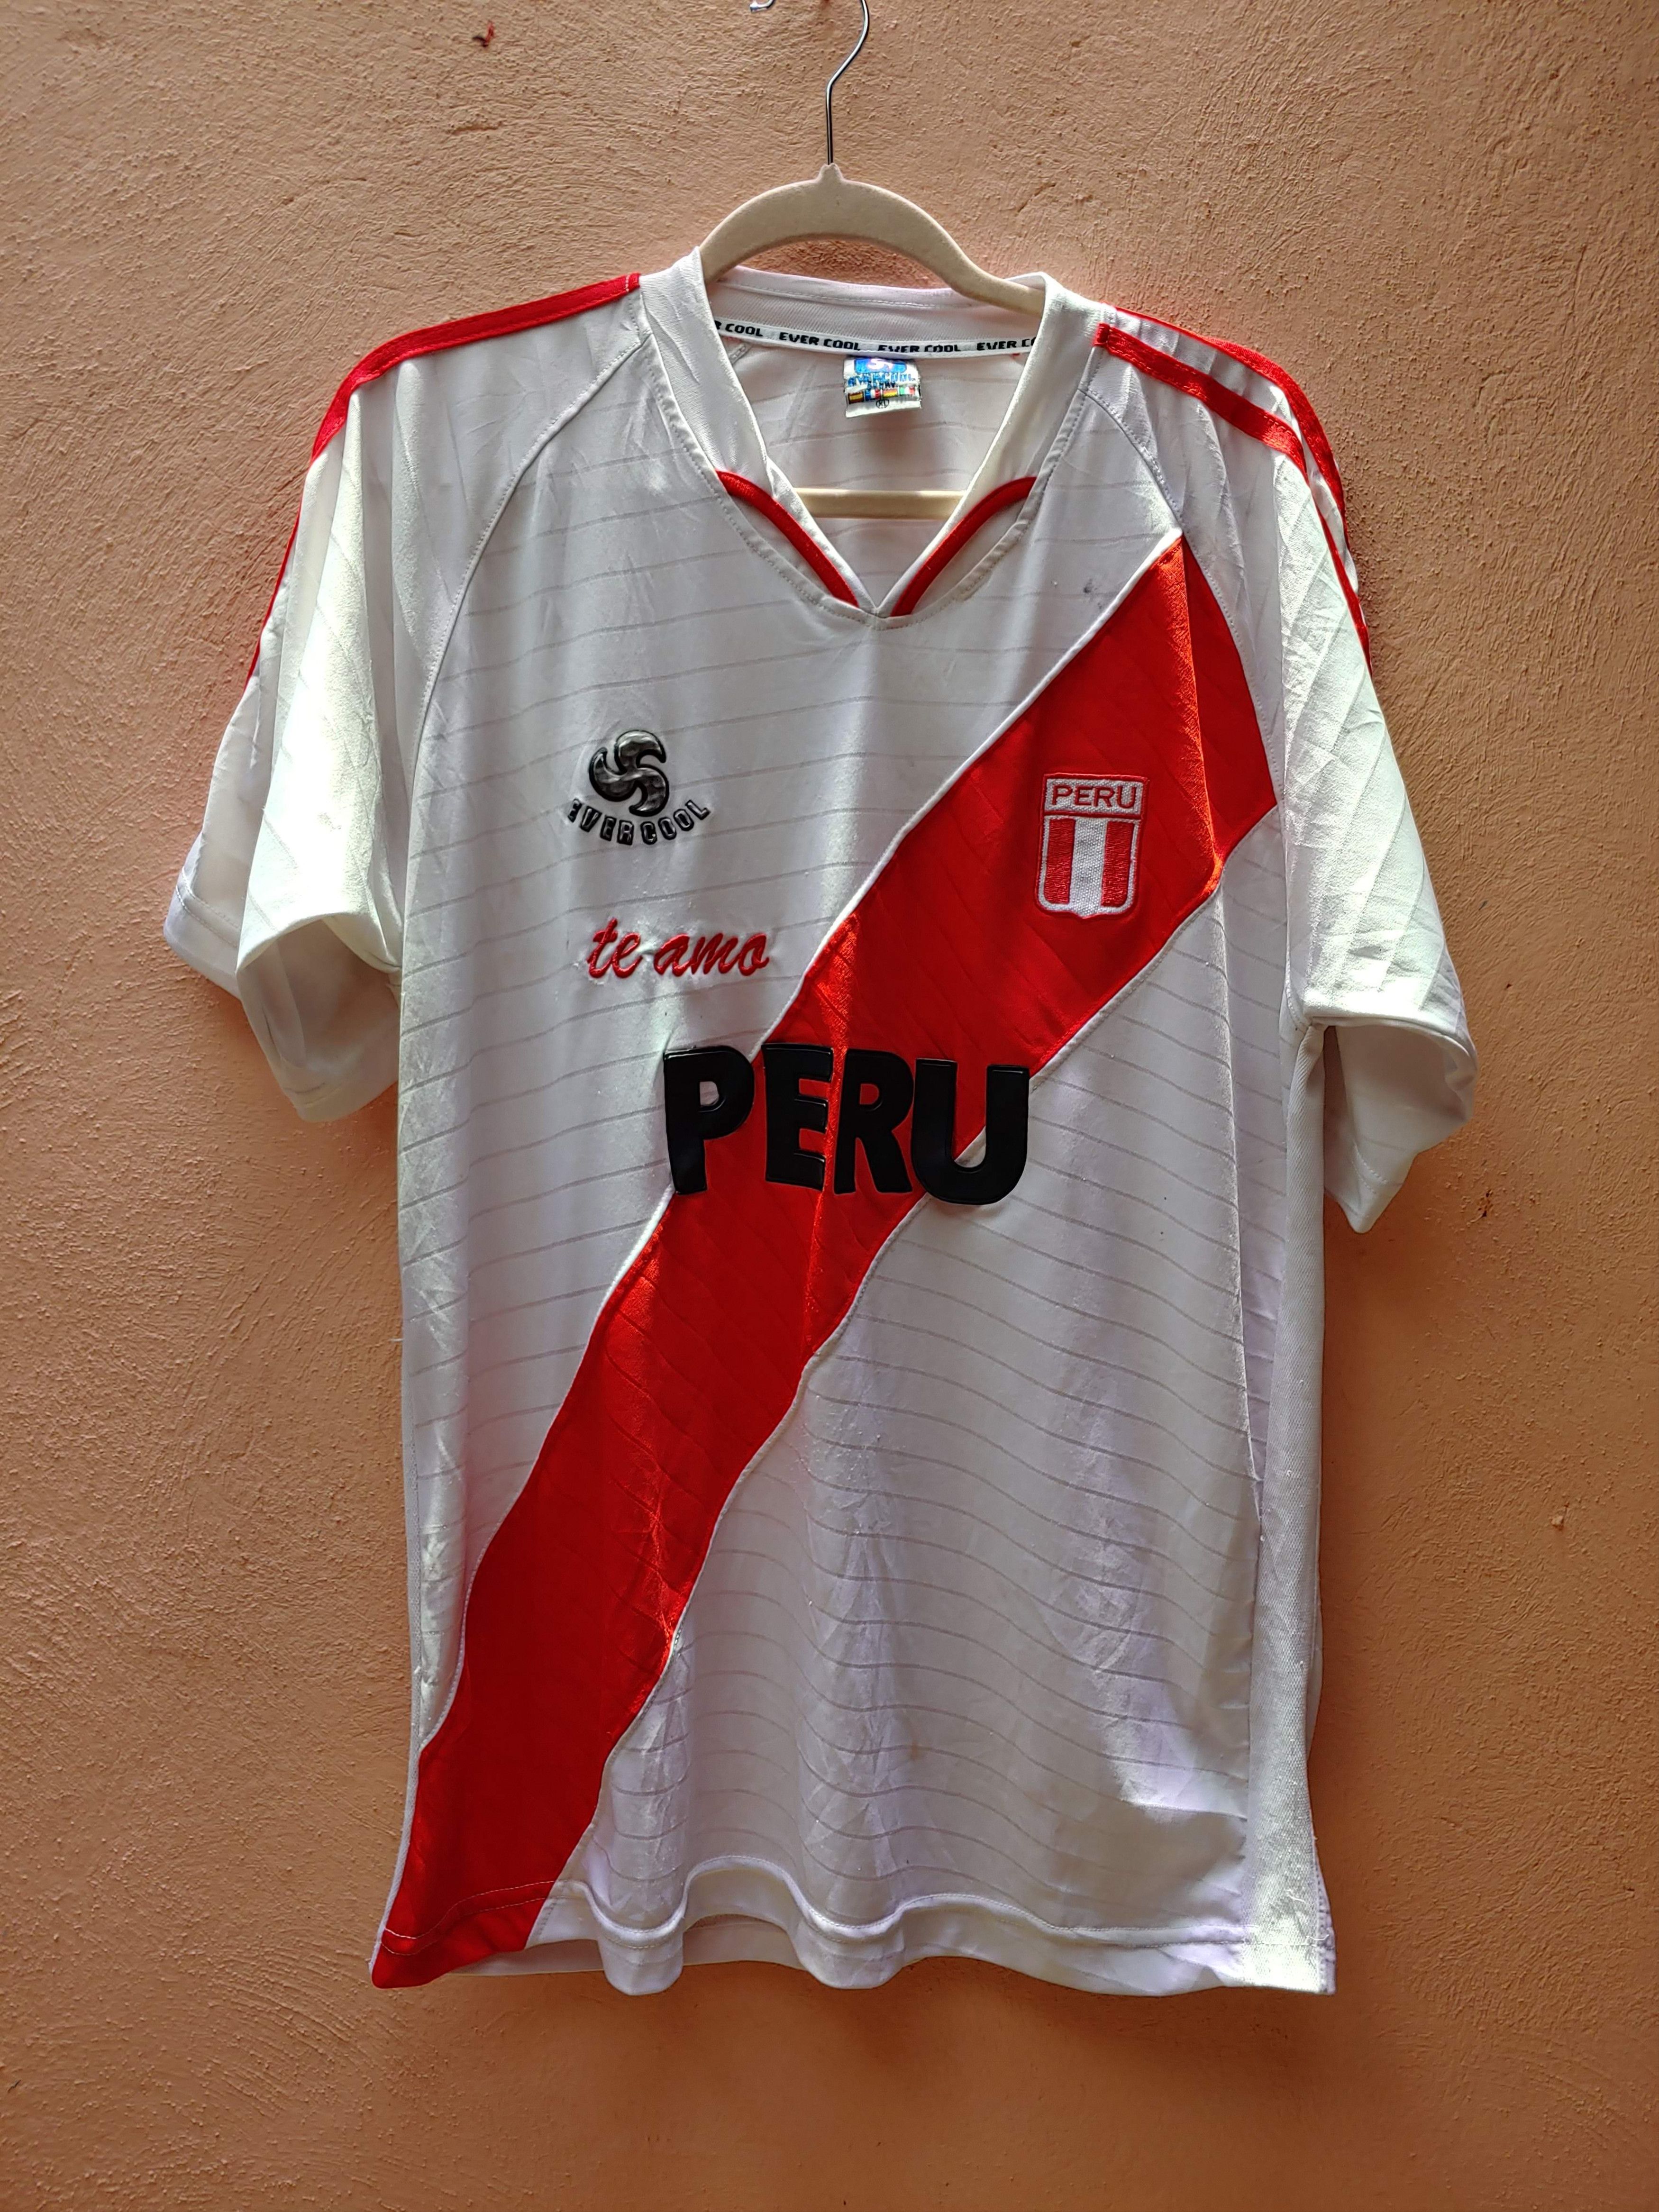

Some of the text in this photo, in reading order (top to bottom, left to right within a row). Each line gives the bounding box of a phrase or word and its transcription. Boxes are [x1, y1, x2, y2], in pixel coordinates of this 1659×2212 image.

[725, 323, 763, 337] COOL
[779, 332, 820, 346] EVER
[823, 338, 861, 351] COOL
[878, 345, 920, 353] EVER
[924, 344, 961, 352] COOL
[976, 341, 1017, 351] EVER
[1051, 785, 1137, 809] PERU
[640, 799, 711, 846] COOL
[587, 918, 770, 978] te amo
[663, 1043, 1030, 1205] PERU
